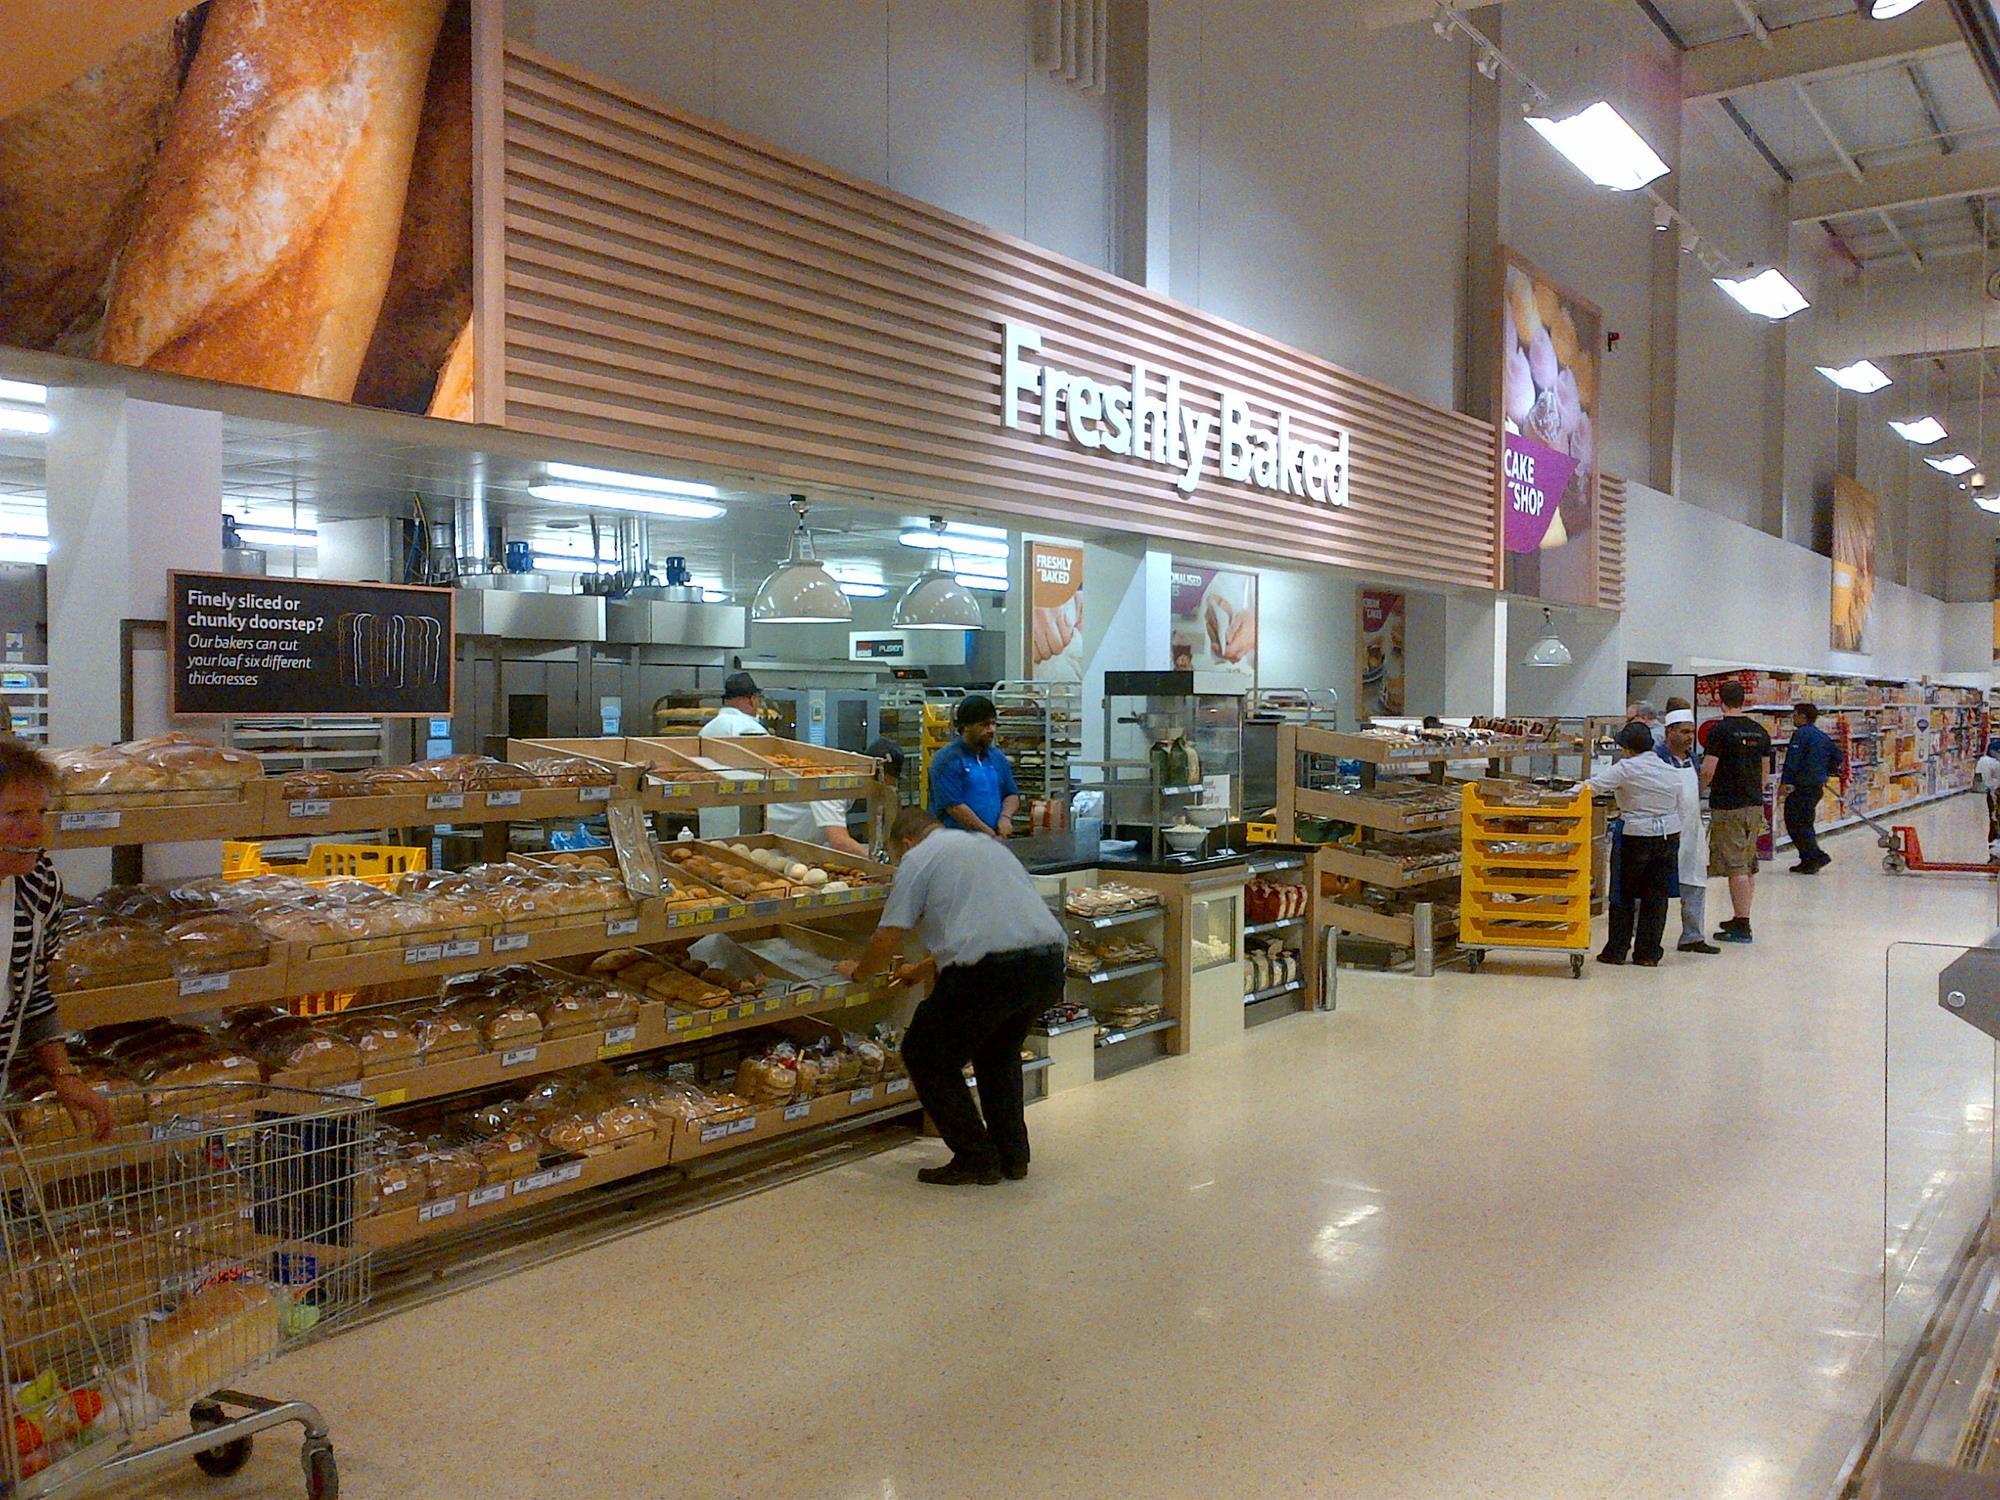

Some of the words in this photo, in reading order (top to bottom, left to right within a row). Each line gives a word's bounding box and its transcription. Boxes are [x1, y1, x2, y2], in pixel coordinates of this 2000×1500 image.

[1001, 323, 1212, 492] Freshly
[1220, 393, 1349, 507] Baked
[1504, 448, 1535, 484] CAKE
[1513, 484, 1544, 516] SHOP
[1036, 554, 1072, 571] FRESHLY
[1041, 569, 1070, 585] BAKED
[1170, 571, 1202, 587] ONALISED
[187, 589, 236, 611] Finely
[238, 593, 282, 610] sliced
[284, 599, 300, 611] or
[187, 611, 247, 631] chunky
[249, 613, 324, 634] doorstep?
[188, 633, 213, 649] Our
[214, 635, 254, 650] bakers
[256, 639, 277, 651] can
[279, 639, 299, 651] cut
[186, 655, 218, 669] your
[218, 653, 244, 671] loaf
[244, 654, 260, 668] six
[261, 655, 312, 671] different
[188, 671, 258, 686] thicknesses
